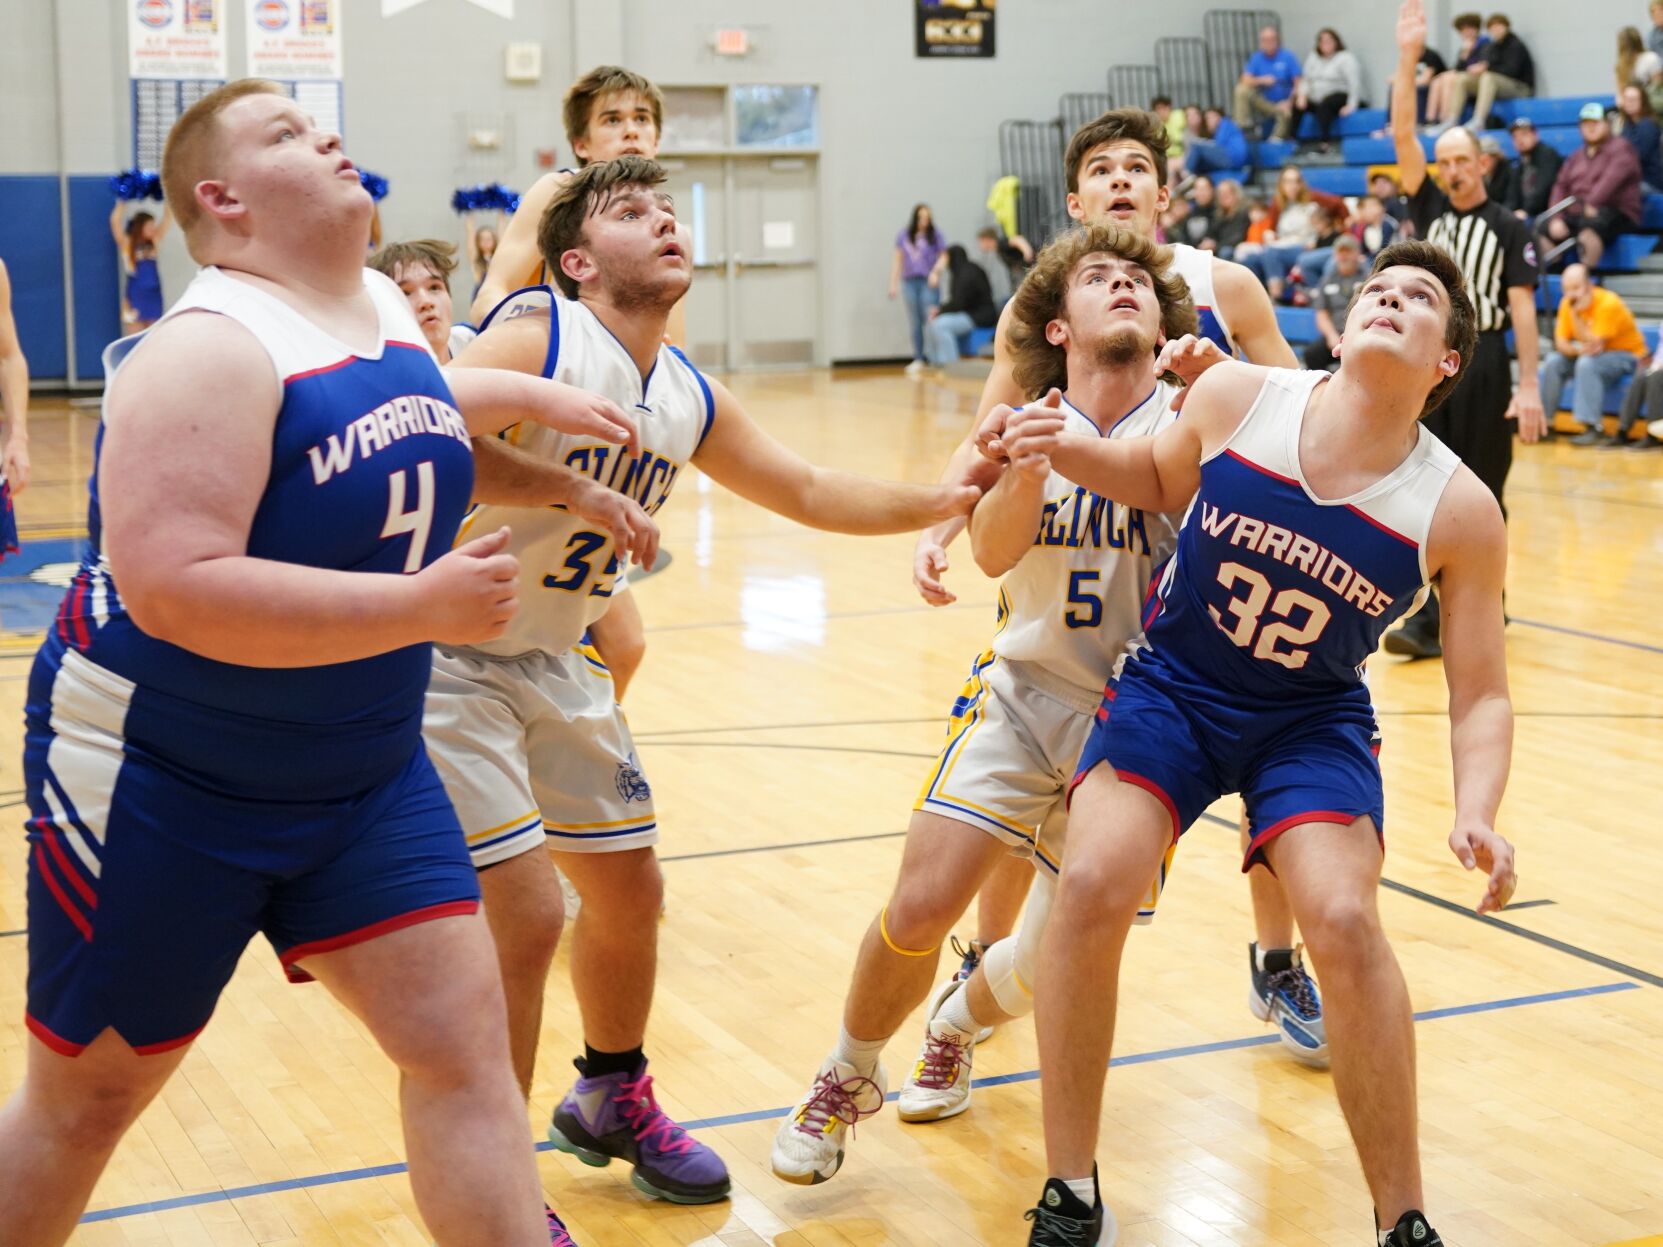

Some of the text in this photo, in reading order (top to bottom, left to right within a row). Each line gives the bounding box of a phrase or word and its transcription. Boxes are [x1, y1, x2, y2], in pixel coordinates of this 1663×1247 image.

[379, 460, 436, 574] 4
[1200, 501, 1395, 618] WARRIORS
[1064, 569, 1105, 630] 5
[1207, 561, 1332, 670] 32
